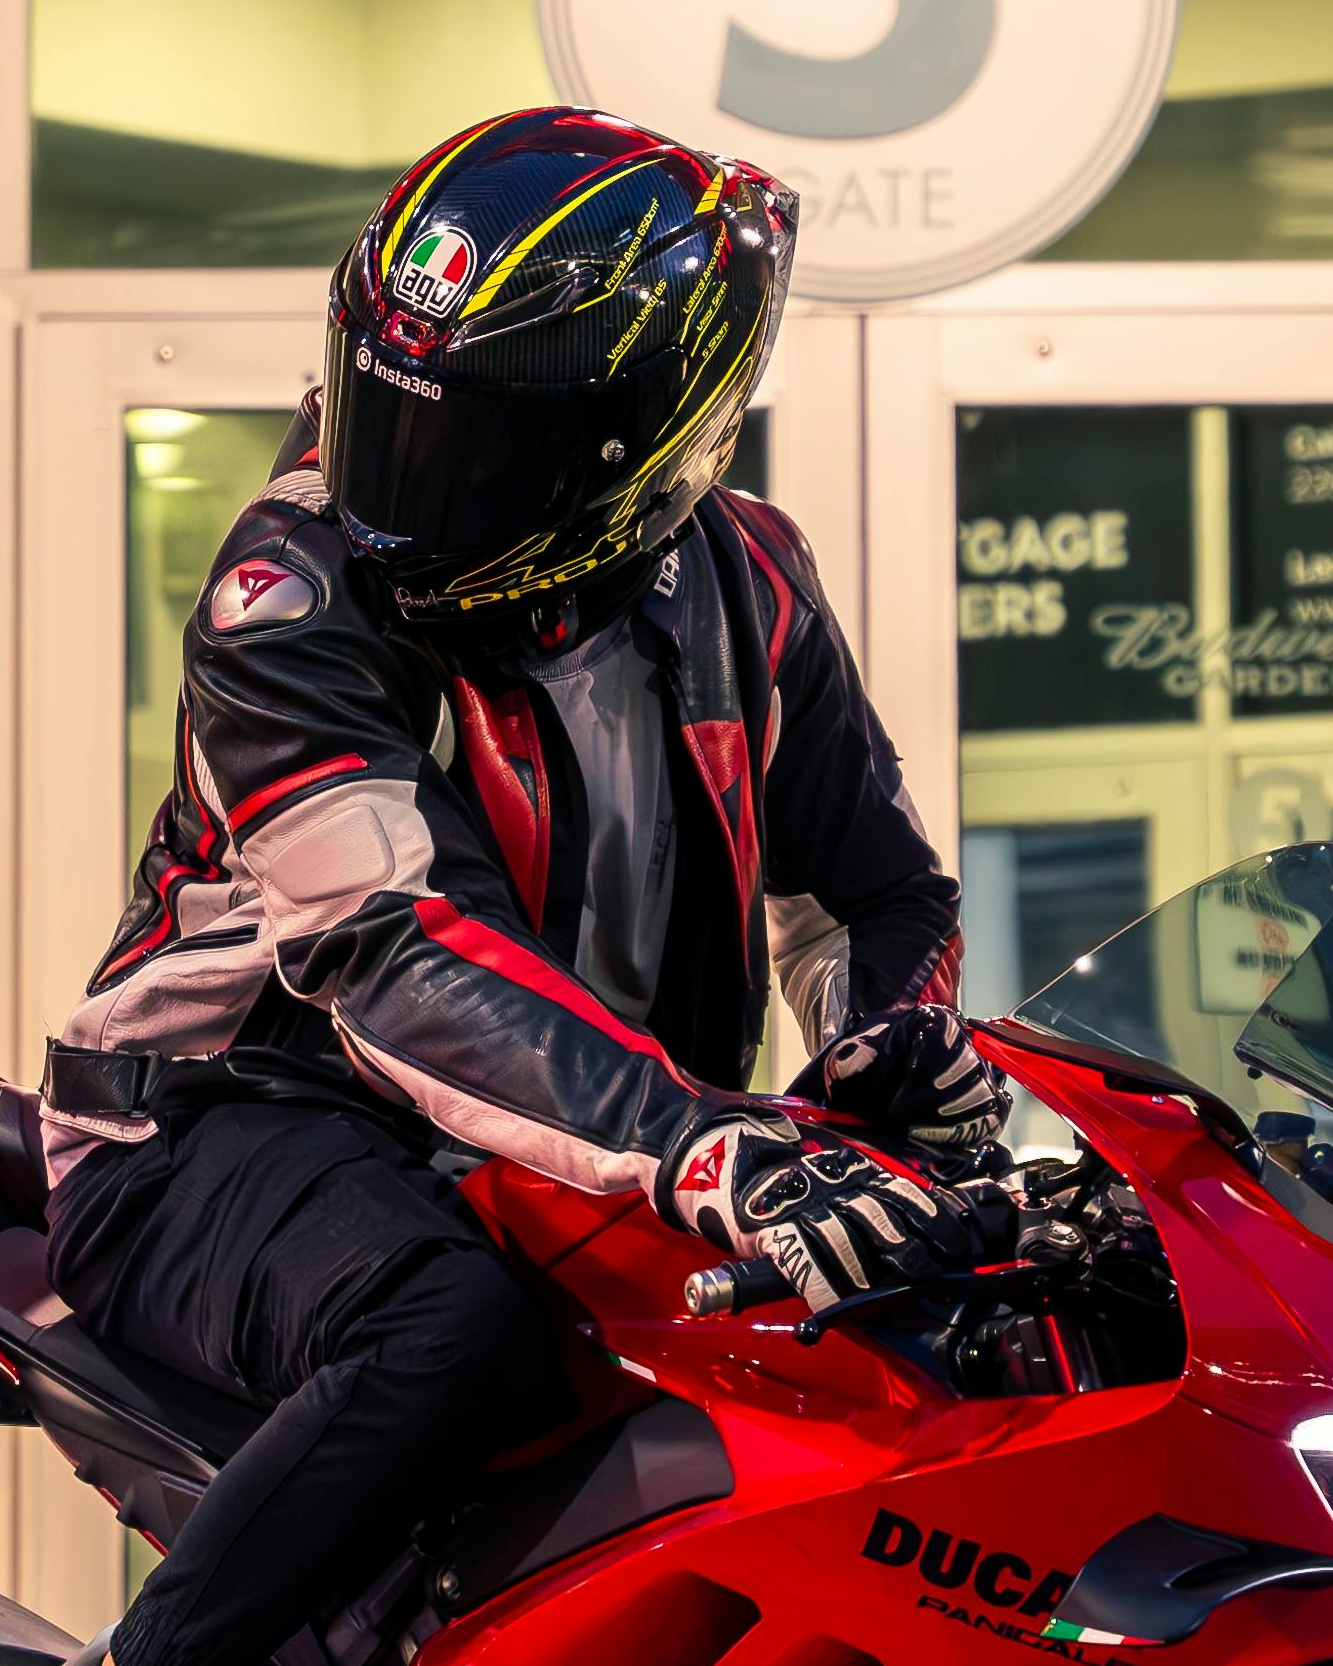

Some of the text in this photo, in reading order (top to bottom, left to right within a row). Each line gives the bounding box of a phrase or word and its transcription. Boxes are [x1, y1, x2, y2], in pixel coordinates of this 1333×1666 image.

[779, 166, 955, 228] GATE
[604, 261, 626, 289] Front
[624, 236, 643, 263] Area
[402, 267, 453, 307] agv
[606, 320, 639, 360] Vertical
[374, 358, 442, 401] Insta360
